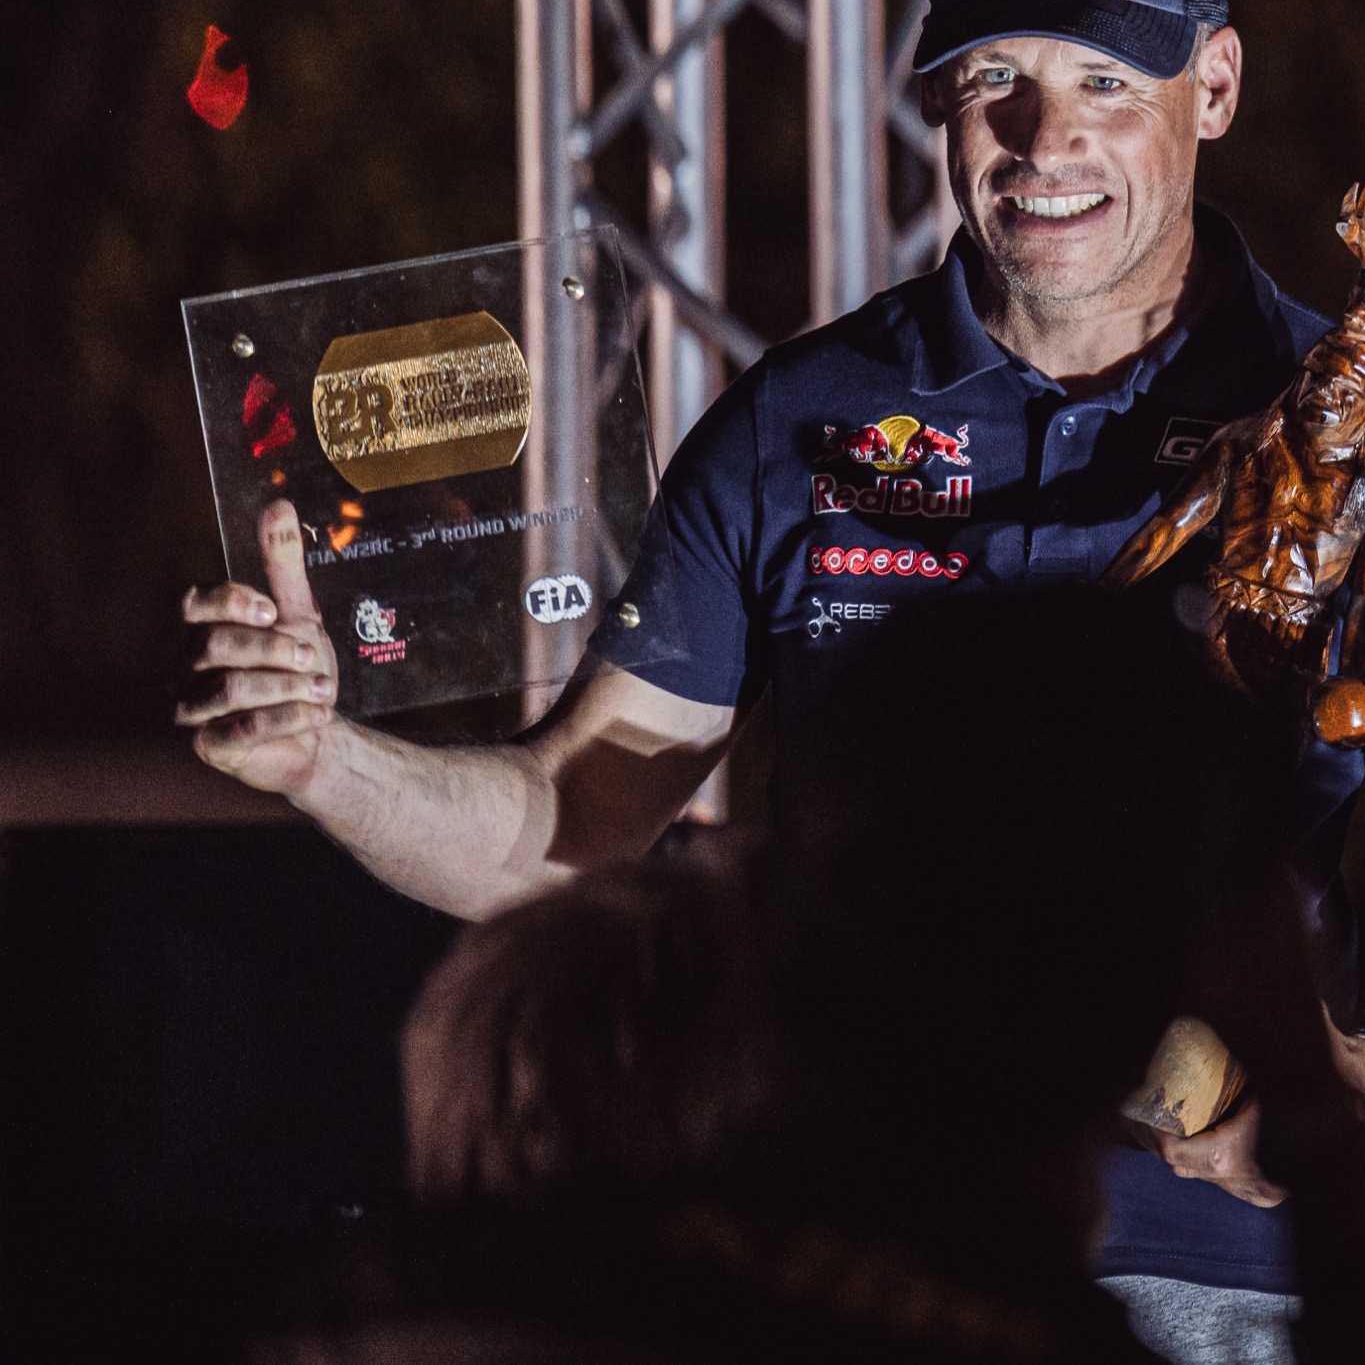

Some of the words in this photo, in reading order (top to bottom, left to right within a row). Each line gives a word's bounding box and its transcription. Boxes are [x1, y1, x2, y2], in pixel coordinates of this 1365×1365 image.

[812, 475, 889, 515] Red
[890, 476, 972, 517] Bull
[440, 517, 505, 543] ROUND
[811, 547, 967, 576] ooredoo
